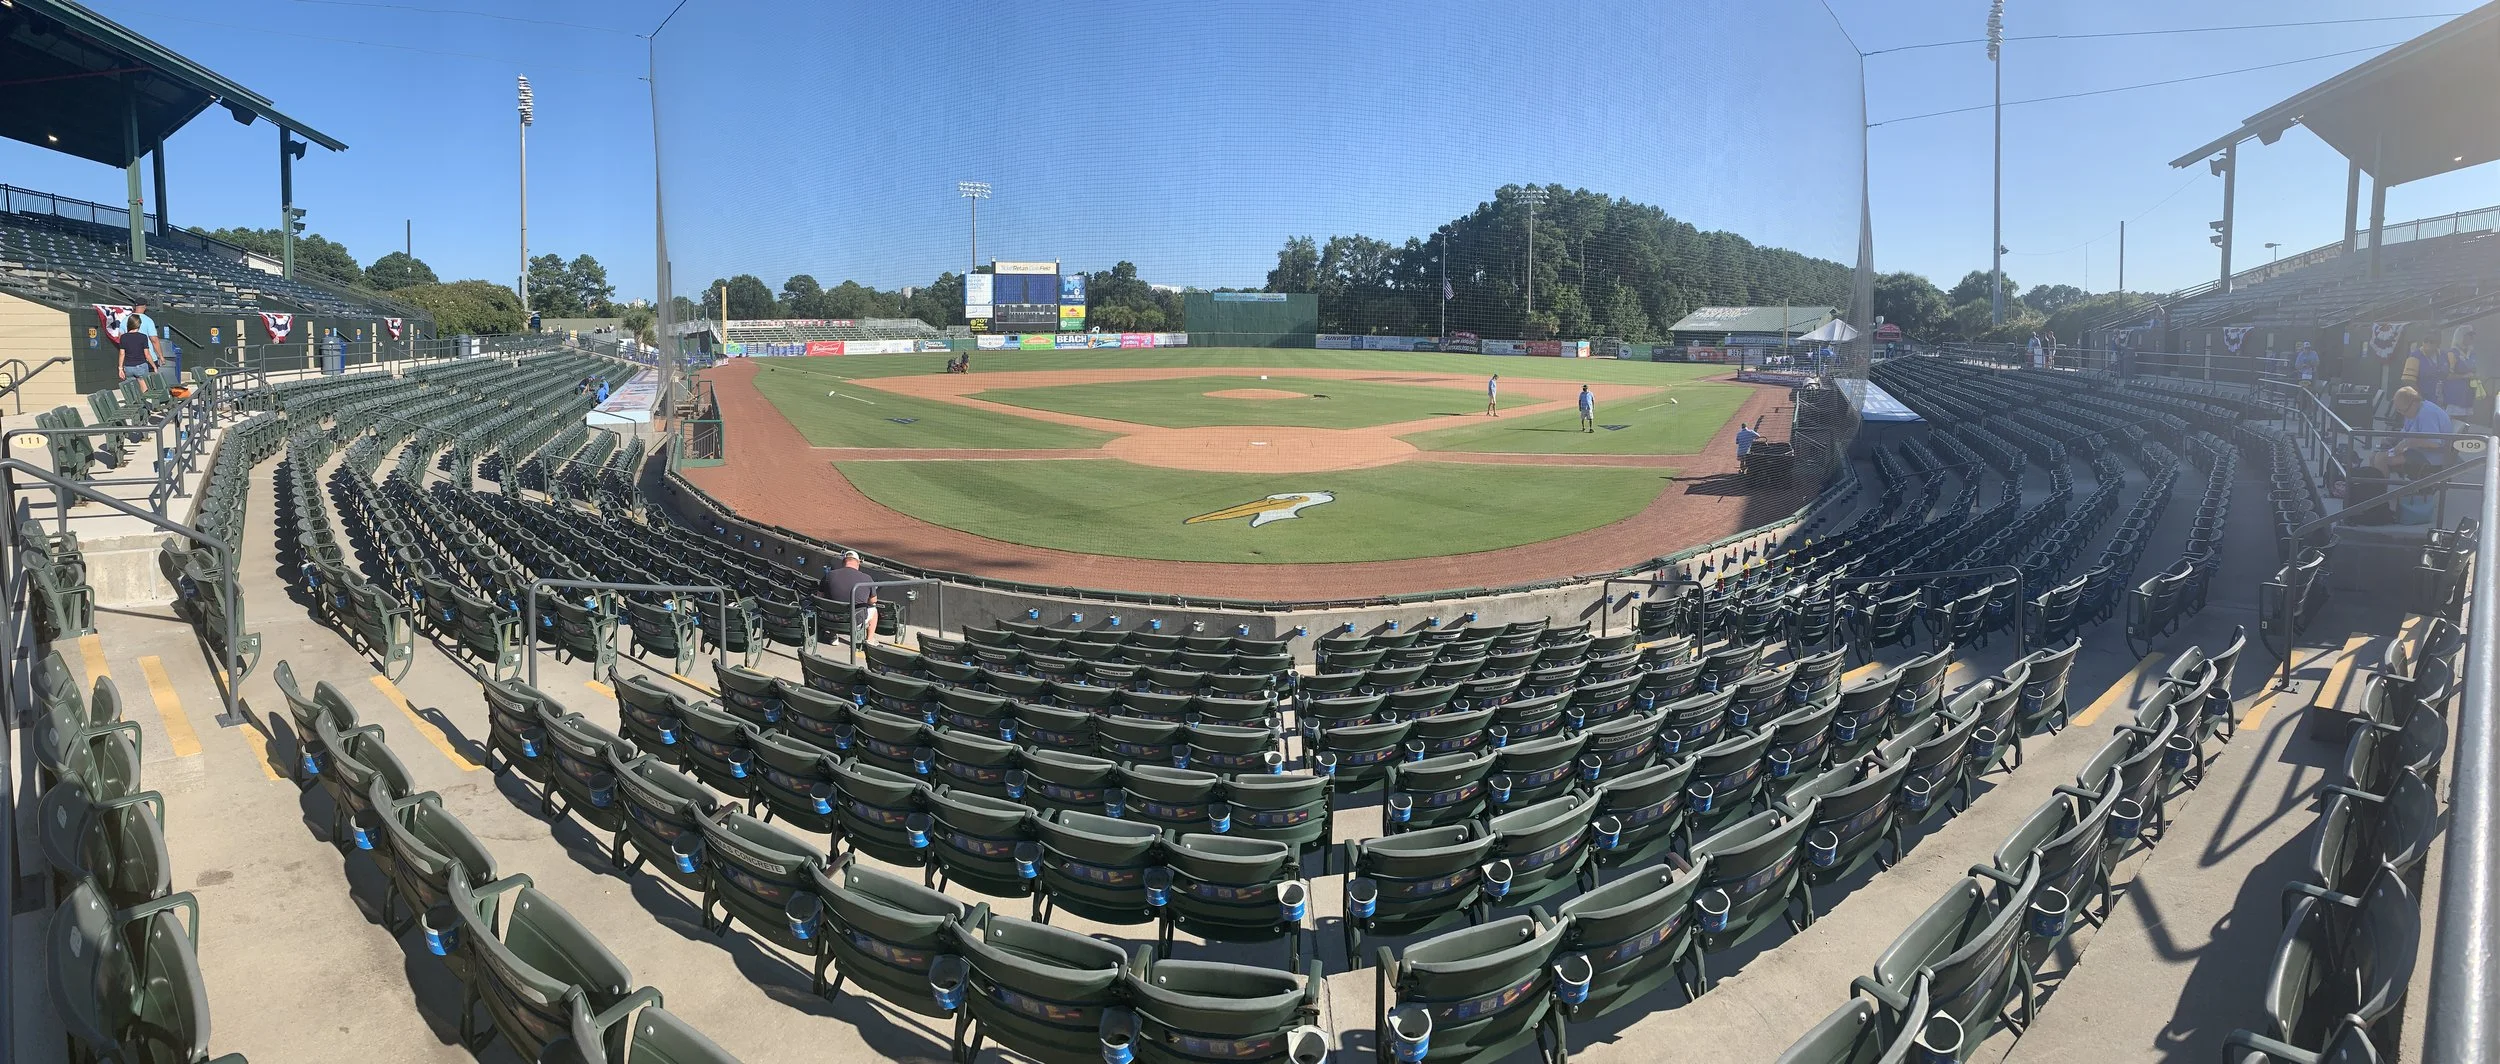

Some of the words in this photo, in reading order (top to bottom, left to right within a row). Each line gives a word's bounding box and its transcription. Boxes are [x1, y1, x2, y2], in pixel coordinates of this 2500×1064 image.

[1056, 335, 1087, 343] BEACH
[20, 437, 40, 445] 111
[2460, 441, 2481, 450] 109
[733, 848, 784, 874] CONCRETE
